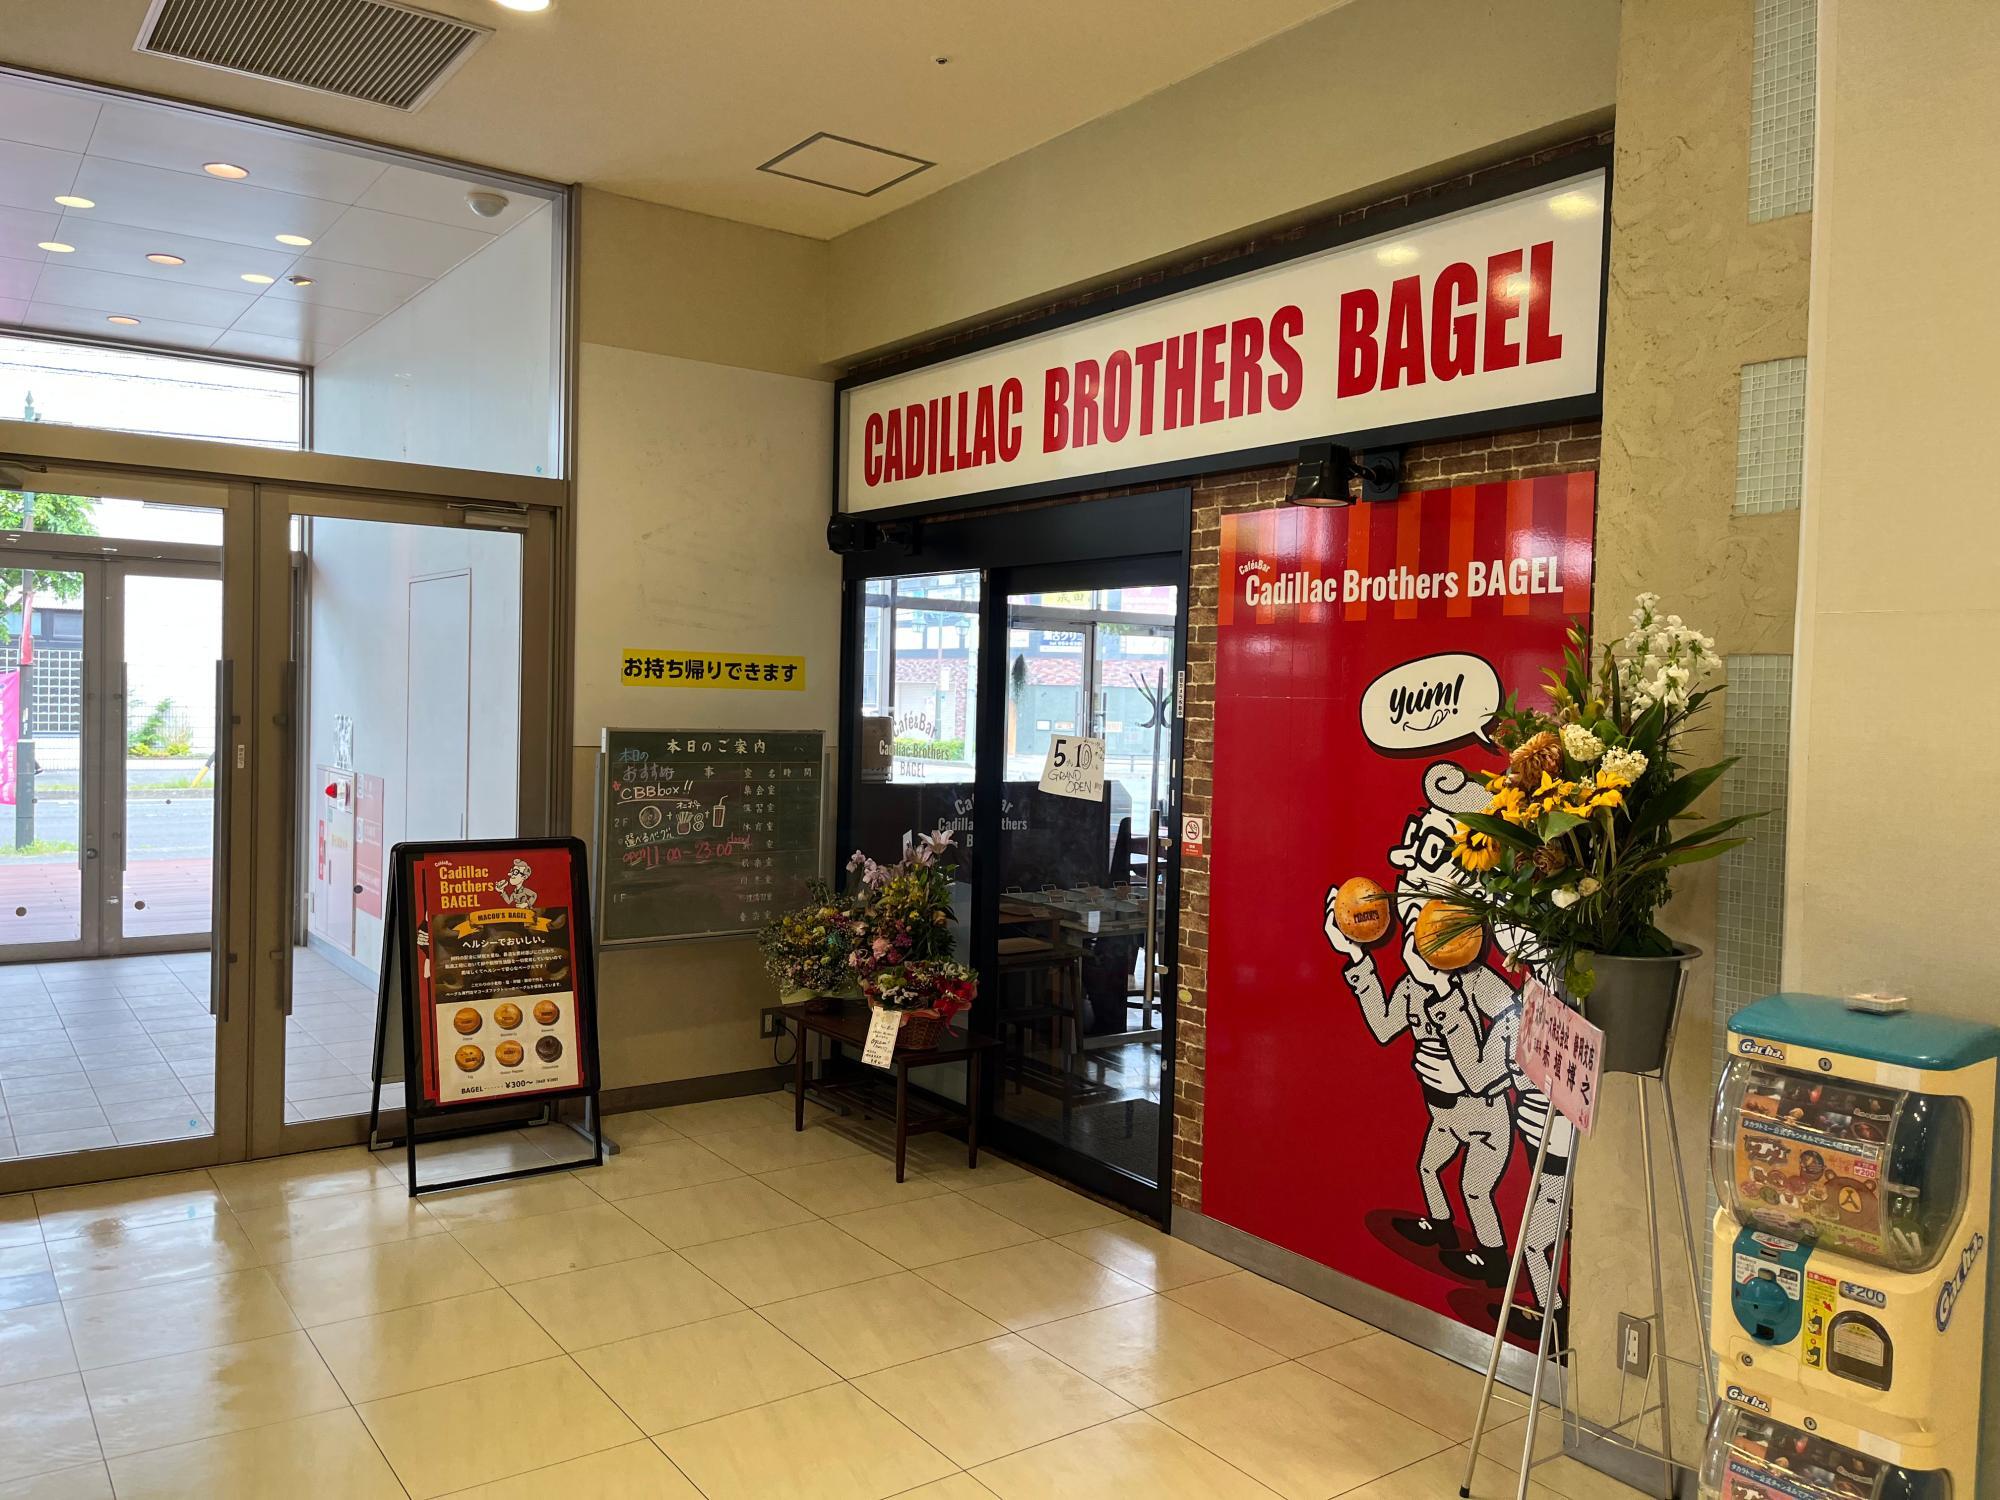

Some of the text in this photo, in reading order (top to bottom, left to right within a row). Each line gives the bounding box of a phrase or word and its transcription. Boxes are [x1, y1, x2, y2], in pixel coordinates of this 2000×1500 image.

[864, 240, 1563, 487] CADILLAC BROTHERS BAGEL
[1245, 556, 1564, 607] Cadillac Brothers BAGEL
[623, 657, 798, 682] お持ち帰りできます
[667, 738, 766, 754] 本日のご案内
[913, 743, 950, 761] Brothers
[619, 747, 649, 763] 本日の
[901, 761, 926, 778] BAGEL
[1048, 769, 1081, 782] GRAND
[1065, 781, 1092, 795] OPEN
[938, 817, 974, 831] Cadilla
[439, 865, 490, 880] Cadillac
[440, 879, 495, 895] Brothers
[441, 894, 481, 909] BAGEL
[462, 935, 546, 949] ヘルシーでおいしい。
[461, 1086, 484, 1095] BAGEL
[1845, 1283, 1886, 1304] ¥200
